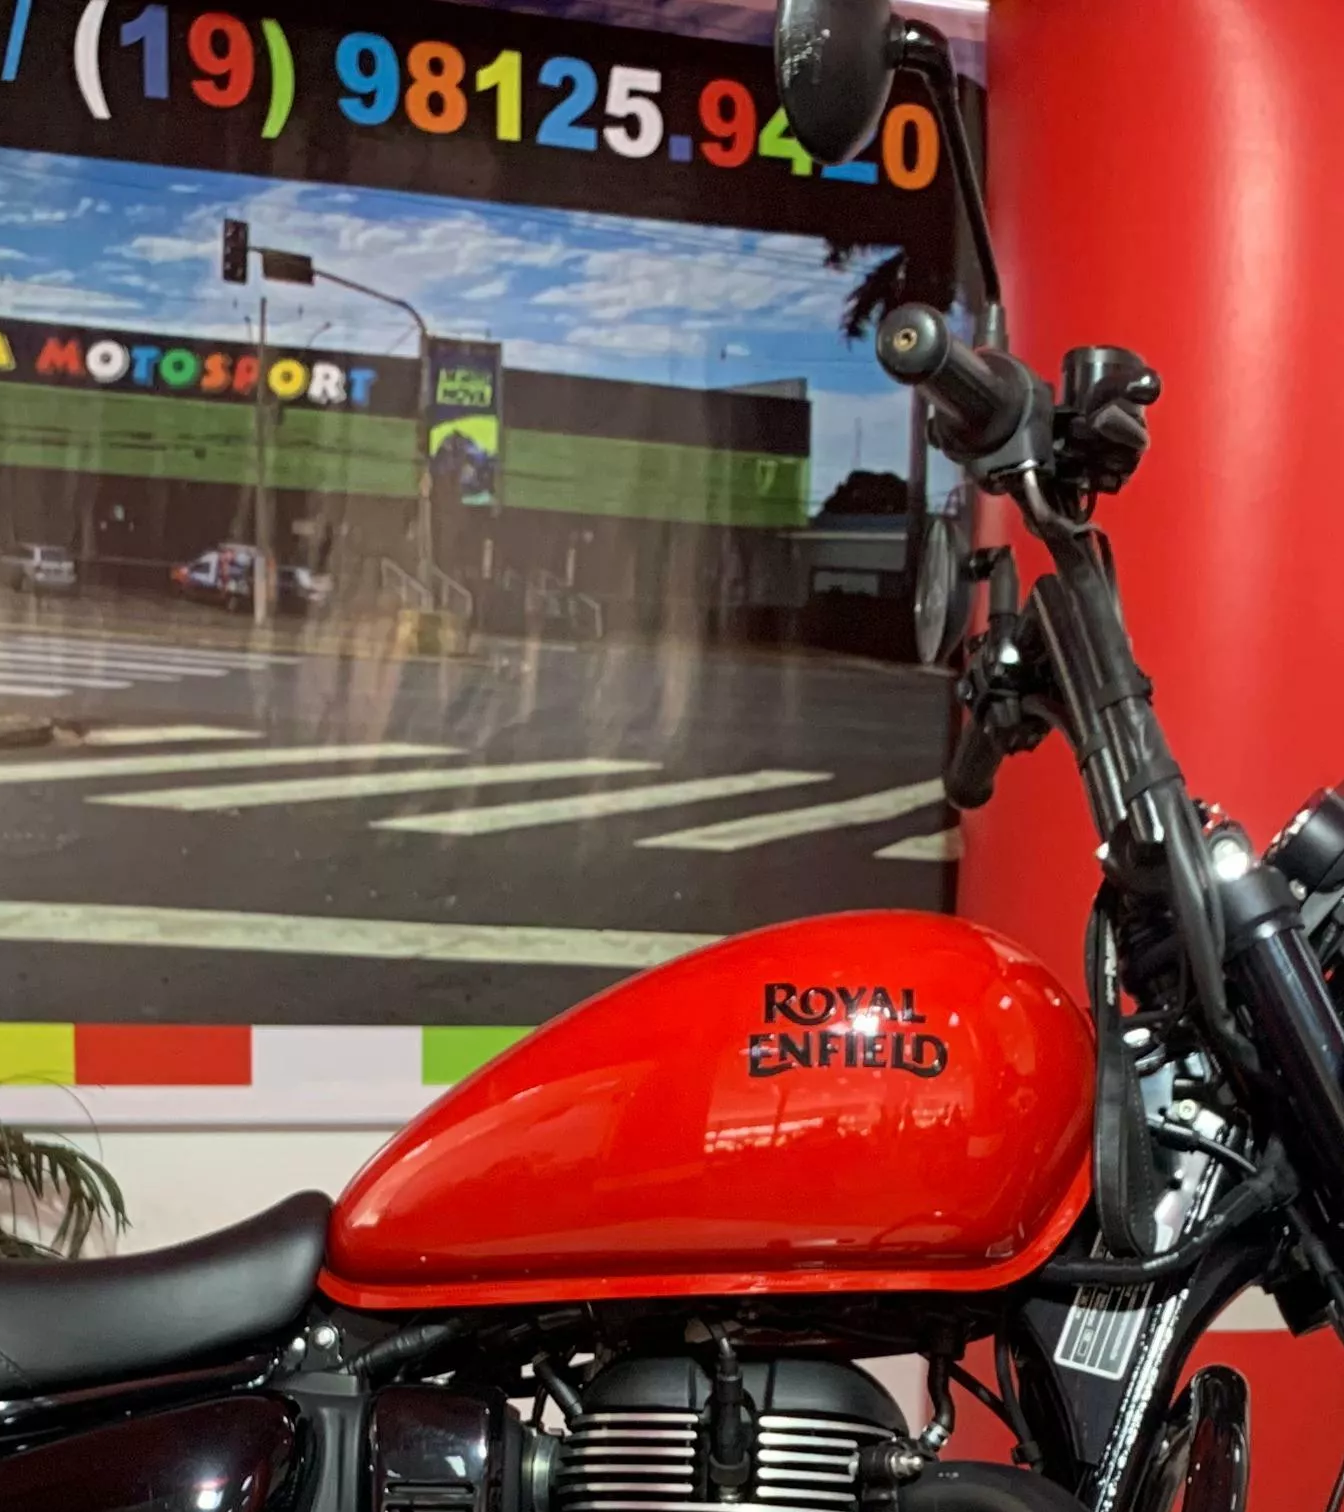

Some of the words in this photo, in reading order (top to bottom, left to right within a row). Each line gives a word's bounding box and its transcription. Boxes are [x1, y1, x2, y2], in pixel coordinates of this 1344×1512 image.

[74, 0, 296, 138] (19)
[35, 336, 378, 405] MOTOSPORT
[763, 983, 926, 1026] ROYAL
[748, 1031, 948, 1078] ENFIELD
